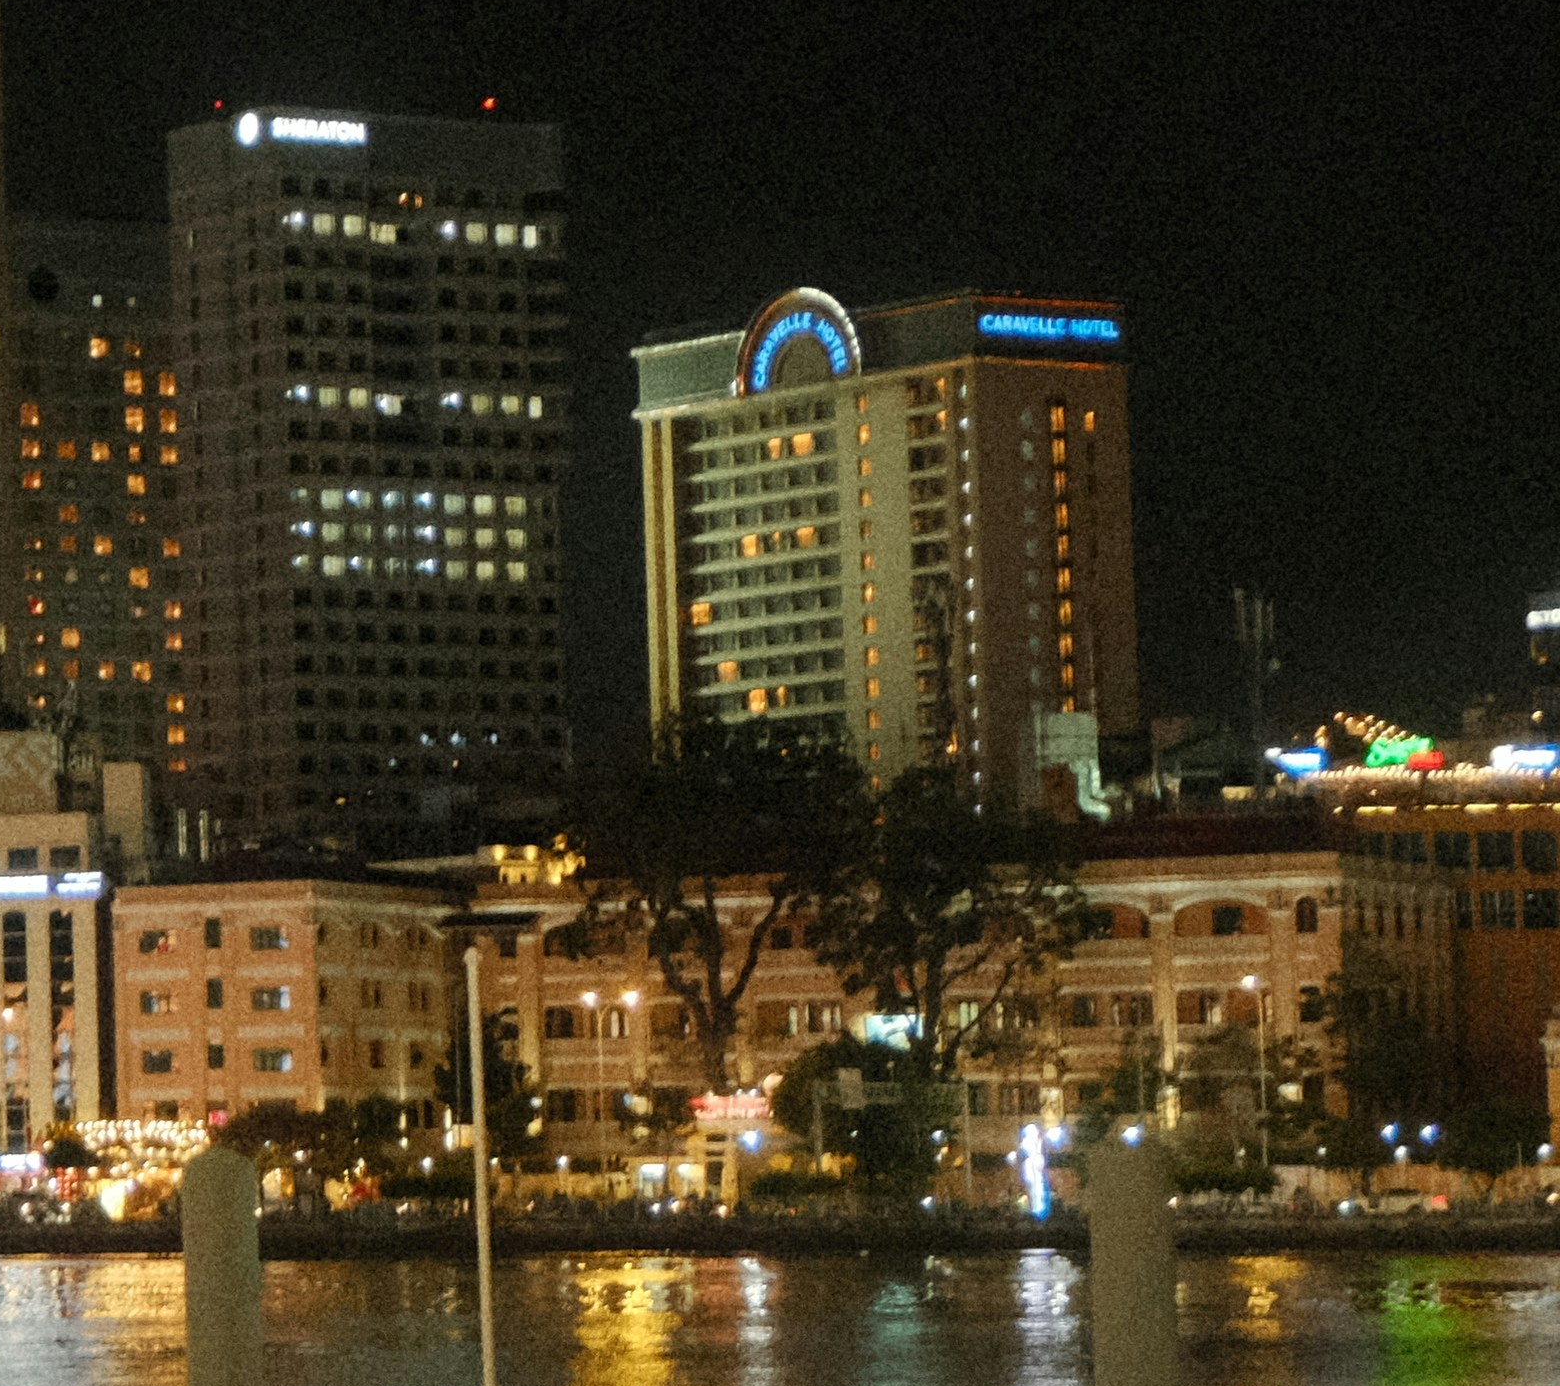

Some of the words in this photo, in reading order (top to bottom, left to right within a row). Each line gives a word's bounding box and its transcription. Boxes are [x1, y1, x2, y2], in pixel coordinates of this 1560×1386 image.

[271, 116, 366, 145] SHERATON
[980, 313, 1066, 337] CARAVELLE
[1070, 318, 1120, 340] HOTEL
